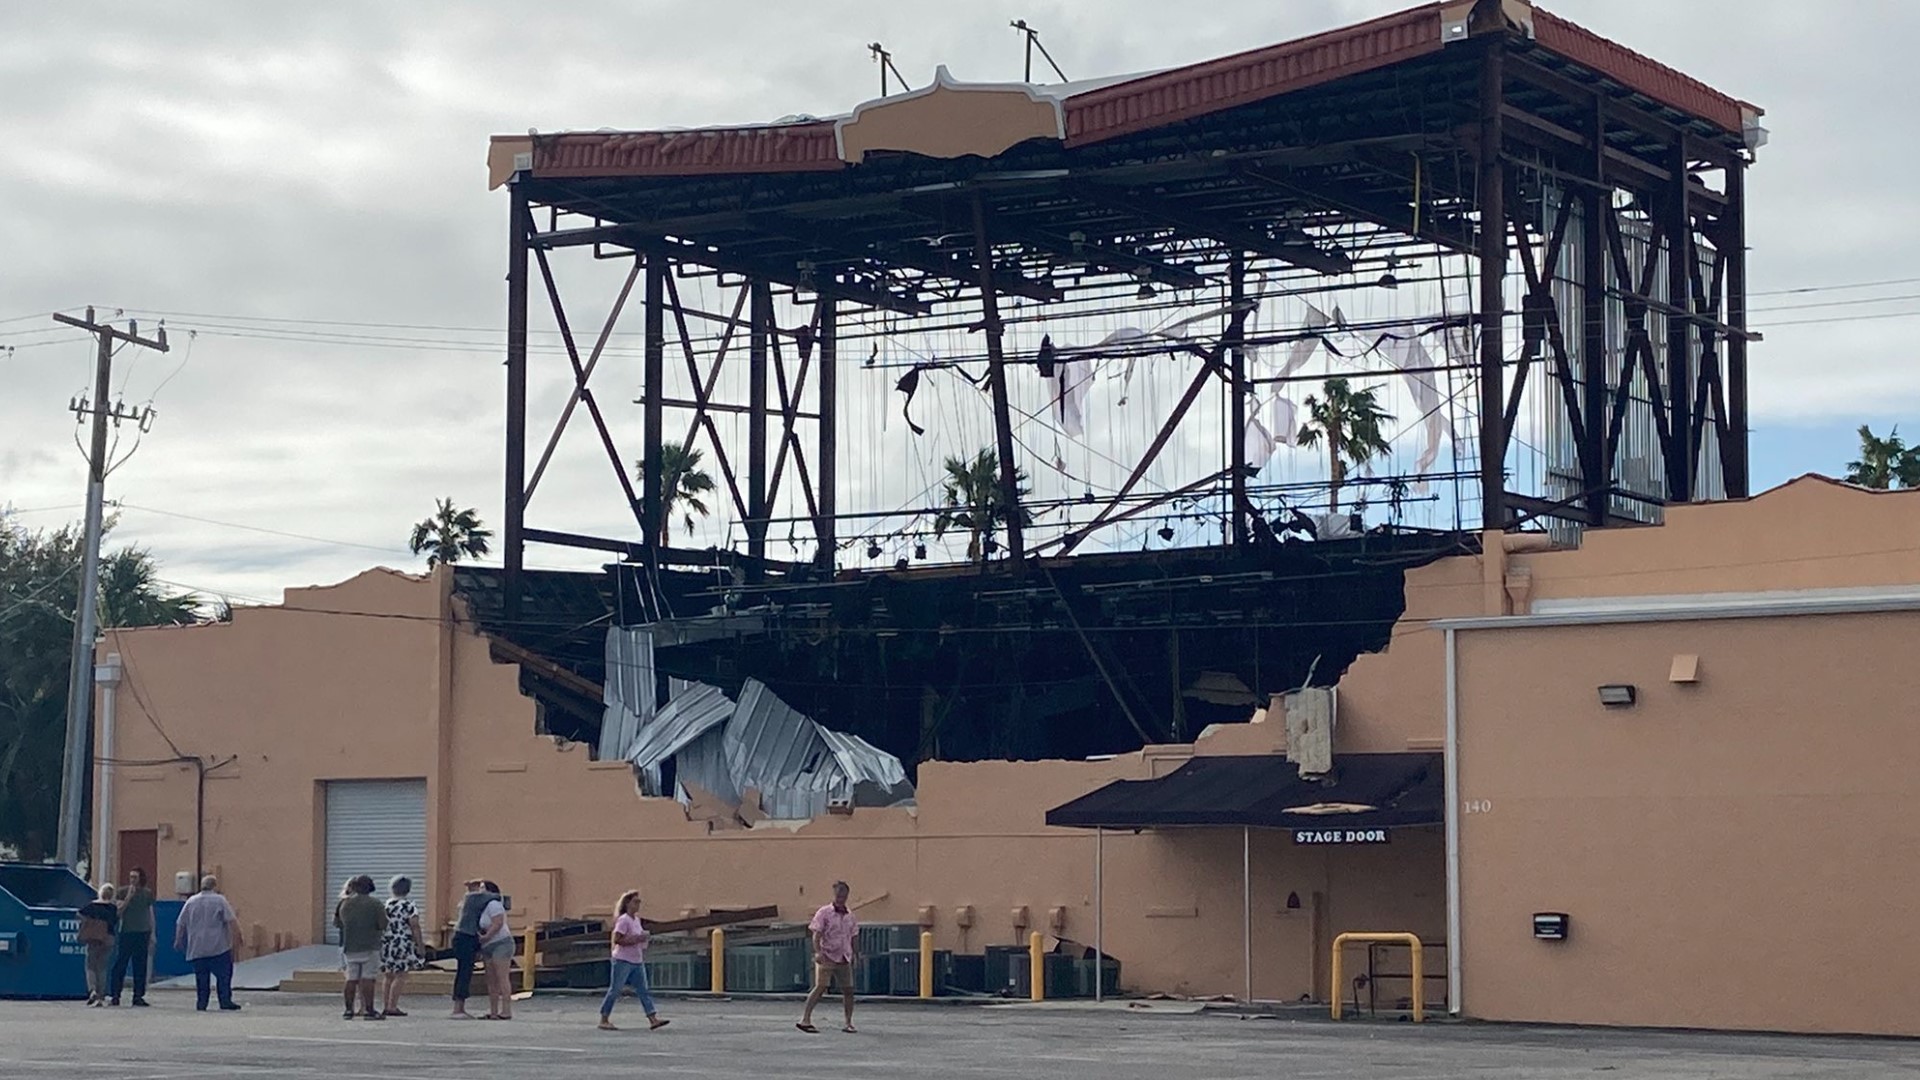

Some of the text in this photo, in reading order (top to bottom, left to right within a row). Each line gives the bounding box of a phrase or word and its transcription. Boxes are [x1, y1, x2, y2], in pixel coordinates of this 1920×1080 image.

[1464, 800, 1492, 814] 140
[1296, 830, 1386, 843] STAGE DOOR
[59, 919, 82, 930] CITY
